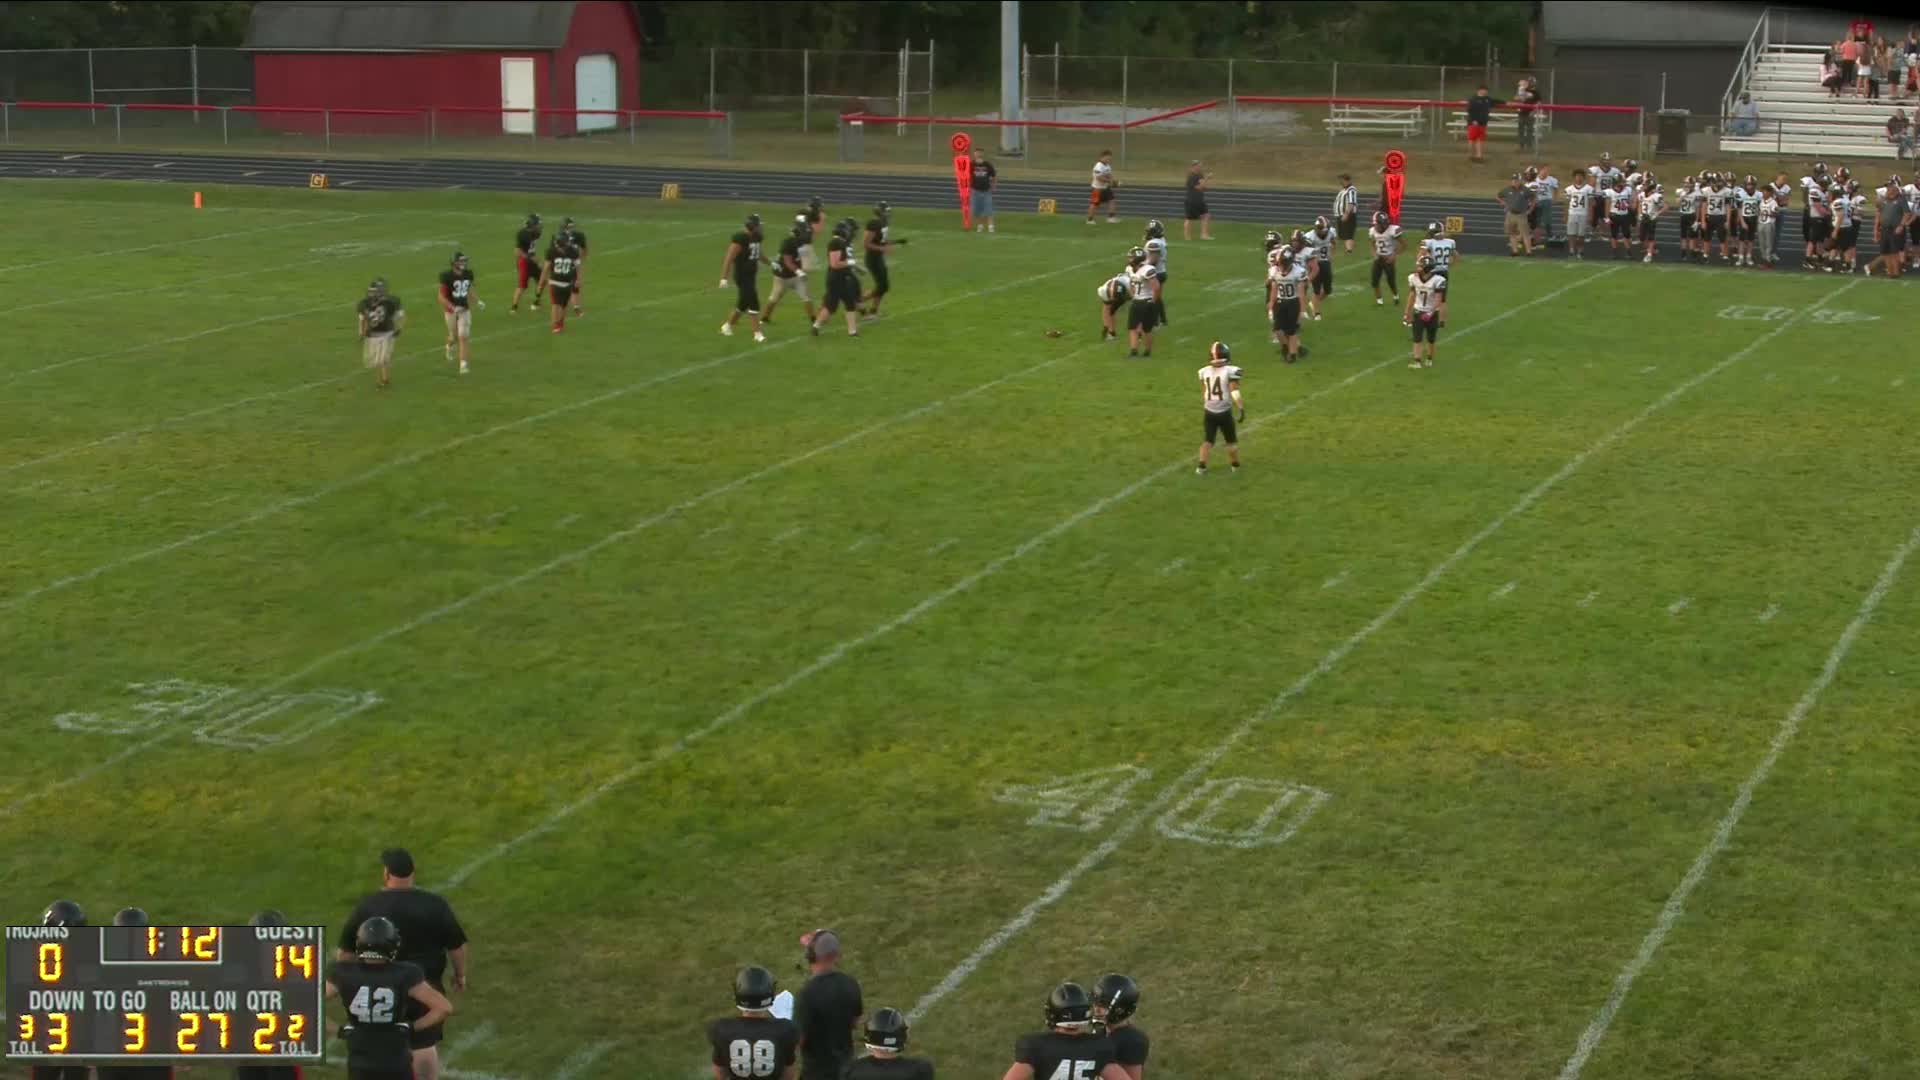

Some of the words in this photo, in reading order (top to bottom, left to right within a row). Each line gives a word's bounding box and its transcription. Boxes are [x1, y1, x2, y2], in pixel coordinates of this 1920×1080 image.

[1572, 195, 1585, 208] 34
[1709, 199, 1722, 210] 54
[1435, 247, 1451, 265] 22
[1206, 376, 1223, 401] 14
[993, 763, 1331, 848] 40
[349, 985, 394, 1024] 42
[729, 1039, 775, 1078] 88
